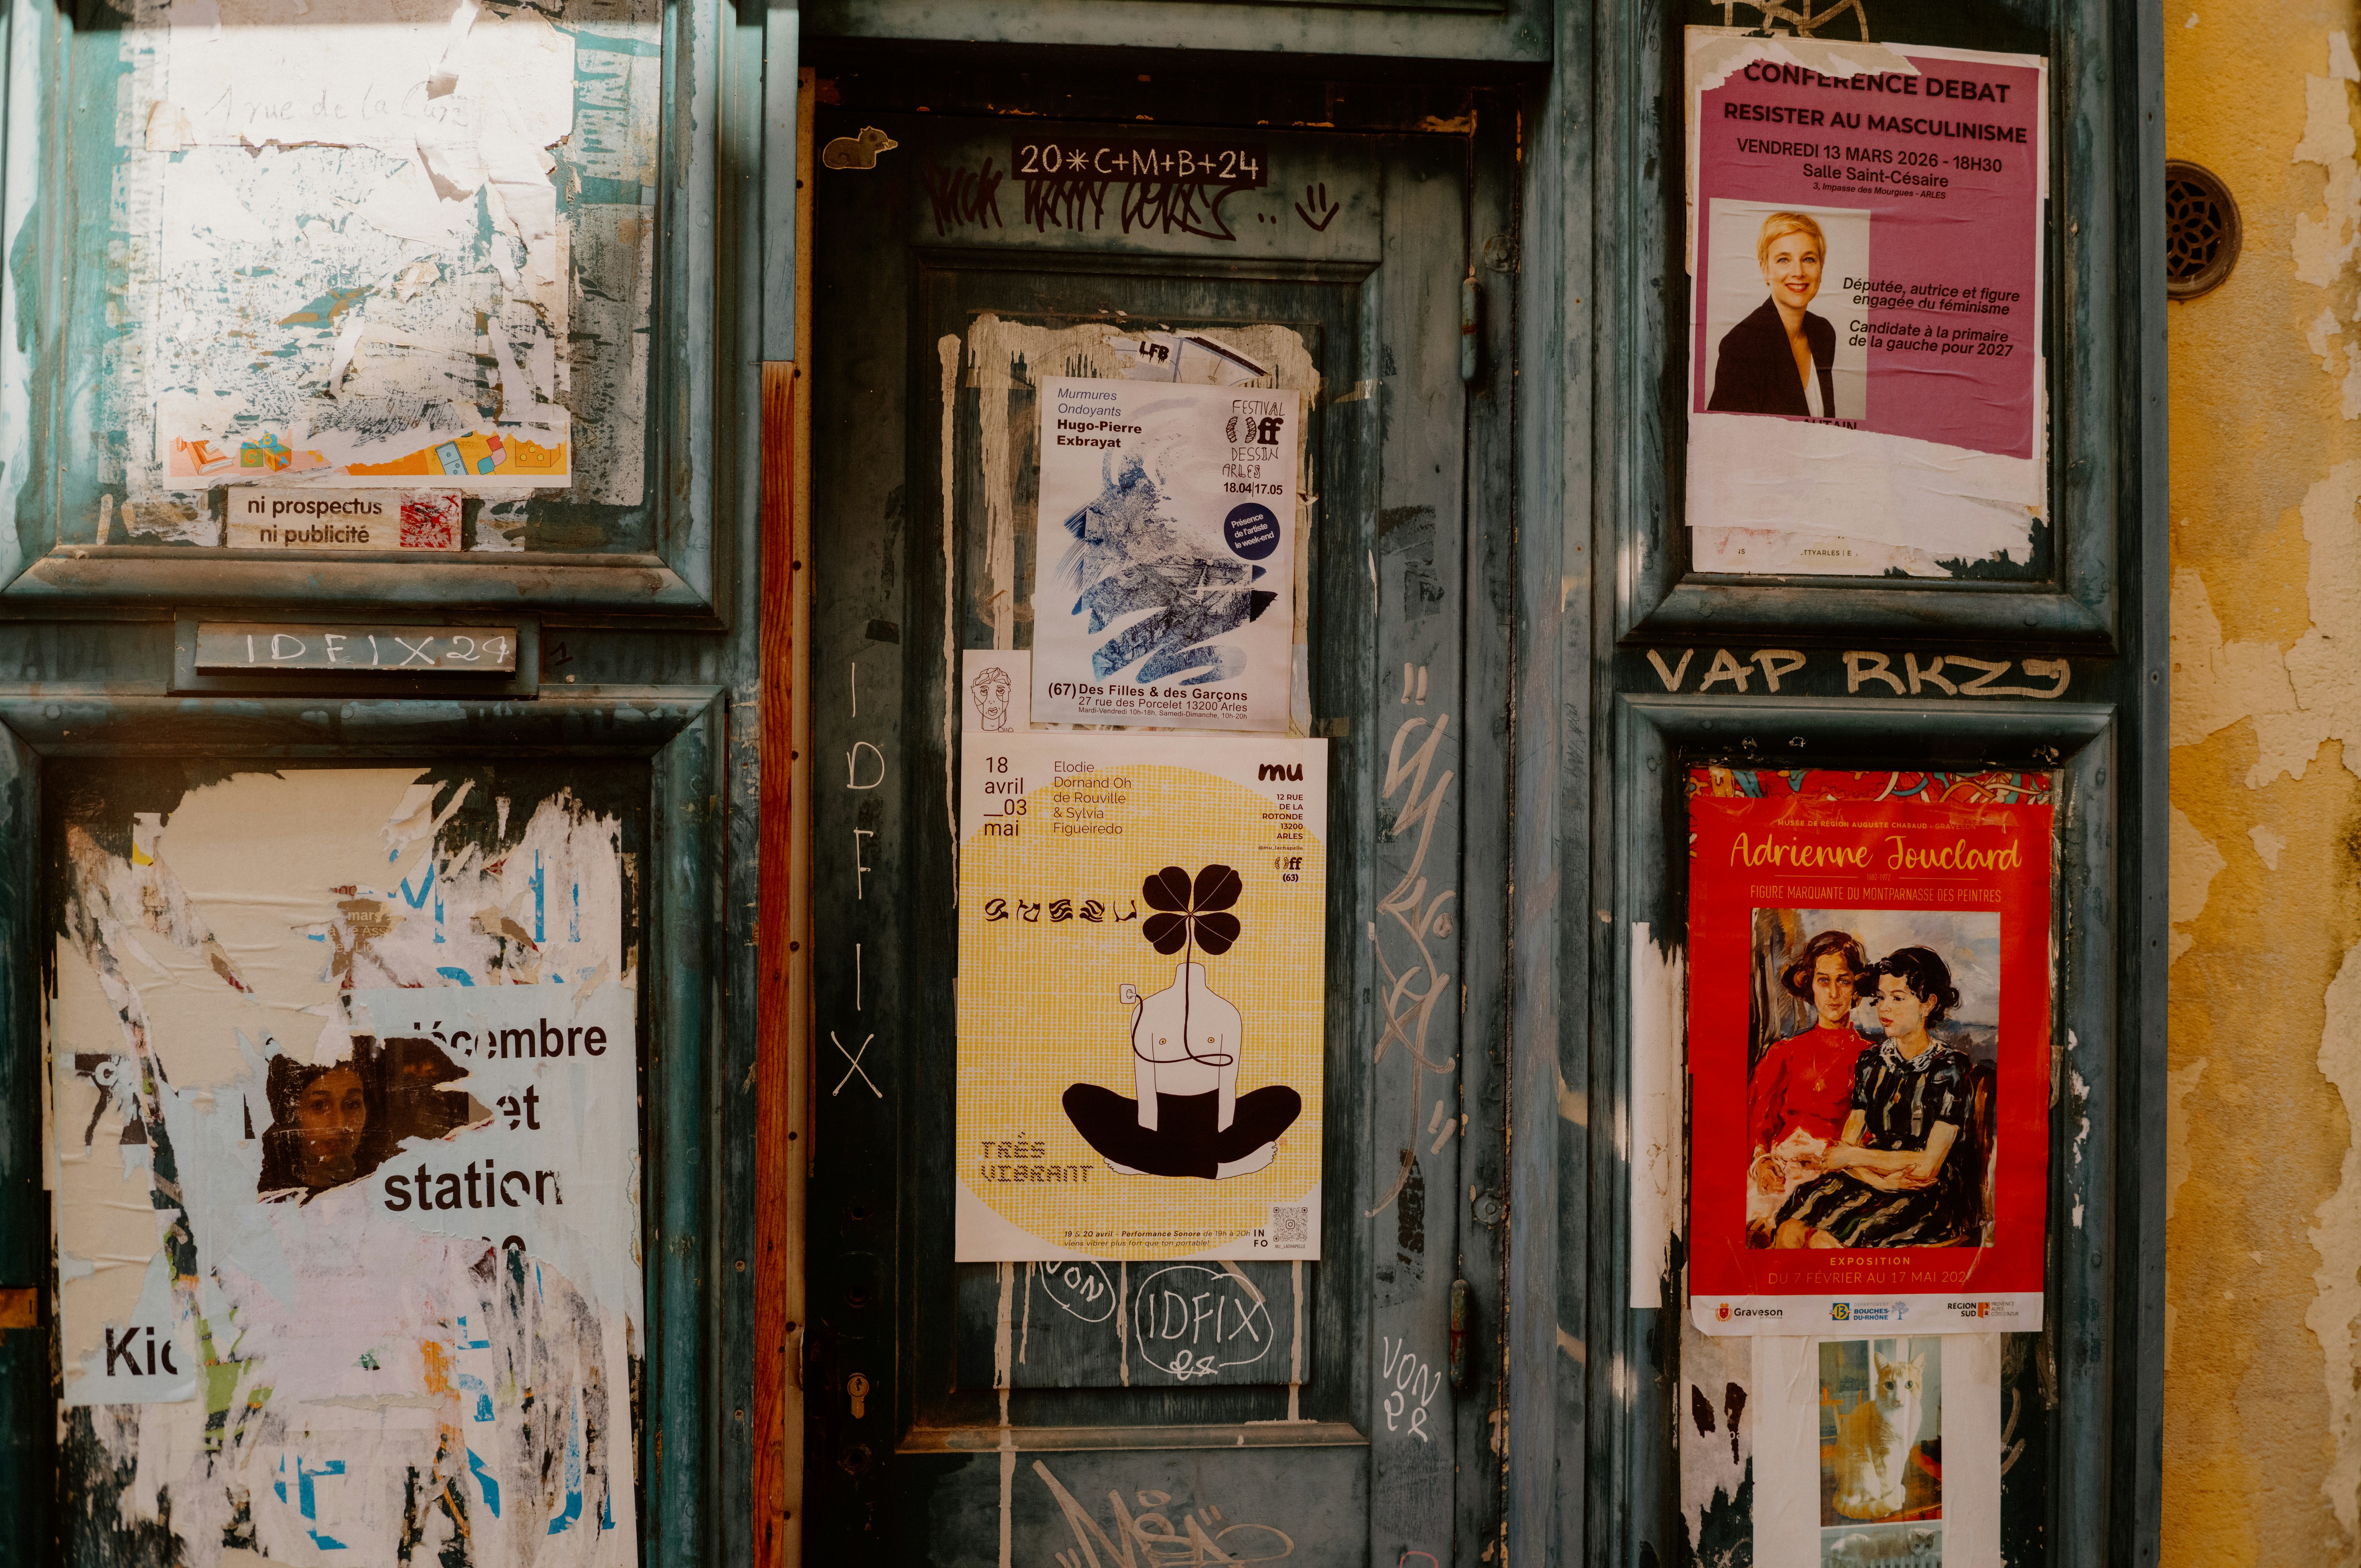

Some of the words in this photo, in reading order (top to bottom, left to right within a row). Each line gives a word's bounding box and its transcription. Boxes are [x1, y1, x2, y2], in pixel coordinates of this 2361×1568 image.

[1744, 63, 1917, 95] CONFERENCE
[1926, 78, 2010, 103] DEBAT
[312, 87, 347, 119] de
[1724, 102, 1824, 126] RESISTER
[1830, 112, 1860, 129] AU
[1868, 114, 2027, 143] MASCULINISME
[1737, 138, 1818, 157] VENDREDI
[1823, 145, 1840, 159] 13
[1846, 147, 1892, 163] MARS
[1898, 151, 1938, 167] 2026
[1953, 155, 2002, 172] 18H30
[1803, 163, 1841, 179] Salle
[1846, 167, 1948, 187] Saint-Césaire
[1813, 182, 1820, 190] 3,
[1822, 183, 1855, 192] Impasse
[1874, 187, 1913, 197] Mourgues
[1920, 190, 1946, 199] ARLES
[1843, 277, 1906, 296] Députée,
[1910, 283, 1958, 297] autrice
[1962, 287, 1976, 298] et
[1980, 288, 2020, 303] figure
[1853, 295, 1914, 309] engagée
[1918, 297, 1935, 309] du
[1940, 299, 2010, 315] féminisme
[1850, 320, 1920, 336] Candidate
[1924, 325, 1932, 337] à
[1936, 326, 1949, 338] la
[1952, 329, 2008, 342] primaire
[1139, 341, 1169, 364] LFB
[1849, 334, 1866, 346] de
[1871, 336, 1883, 347] la
[1886, 339, 1938, 351] gauche
[1941, 342, 1974, 355] pour
[1977, 343, 2013, 356] 2027
[1058, 388, 1117, 401] Murmures
[1059, 403, 1121, 417] Ondoyants
[1232, 400, 1285, 416] FESTIVAL
[1058, 419, 1142, 434] Hugo-Pierre
[1057, 435, 1121, 449] Exbrayat
[1232, 447, 1278, 461] DESSIN
[1223, 464, 1260, 478] ARLES
[248, 495, 265, 513] ni
[273, 497, 382, 519] prospectus
[1231, 514, 1264, 528] Présence
[260, 524, 277, 542] ni
[285, 524, 369, 547] publicité
[1242, 531, 1275, 547] week-end
[1647, 648, 1806, 693] VAP
[1048, 683, 1076, 699] (67)
[1079, 683, 1103, 694] Des
[1109, 685, 1144, 696] Filles
[1150, 687, 1158, 697] &
[1164, 687, 1187, 698] des
[1192, 688, 1247, 702] Garçons
[1079, 696, 1091, 705] 27
[1116, 698, 1134, 707] des
[1139, 699, 1182, 709] Porcelet
[1186, 701, 1217, 711] 13200
[1221, 702, 1247, 712] Arles
[1159, 710, 1219, 718] Samedi-Dimanche,
[986, 757, 1008, 773] 18
[1055, 761, 1094, 772] Elodie
[1258, 763, 1303, 781] mu
[985, 778, 1023, 794] avril
[1054, 777, 1109, 788] Dornand
[1114, 778, 1131, 788] Oh
[1054, 792, 1070, 803] de
[1075, 792, 1126, 803] Rouville
[1053, 807, 1062, 818] &
[1066, 807, 1104, 821] Sylvia
[984, 820, 1018, 836] mai
[1054, 822, 1122, 836] Figueiredo
[1731, 832, 1873, 868] Adrienne
[1885, 835, 2022, 870] Jouclard
[1282, 873, 1299, 882] (63)
[1751, 885, 1783, 898] FIGURE
[1788, 886, 1843, 899] MARQUANTE
[1848, 887, 1859, 899] DU
[1863, 887, 1934, 901] MONTPARNASSE
[1938, 888, 1954, 901] DES
[1958, 889, 2001, 902] PEINTRES
[496, 1084, 540, 1130] et
[981, 1165, 1093, 1182] VIBRANT
[384, 1159, 563, 1211] station
[1830, 1257, 1910, 1265] EXPOSITION
[1769, 1272, 1788, 1284] DU
[1795, 1273, 1801, 1284] 7
[1807, 1270, 1861, 1284] FÉVRIER
[1867, 1272, 1884, 1283] AU
[1892, 1272, 1906, 1283] 17
[1912, 1272, 1936, 1282] MAI
[1149, 1290, 1262, 1344] IDFIX
[1734, 1308, 1783, 1316] Graveson
